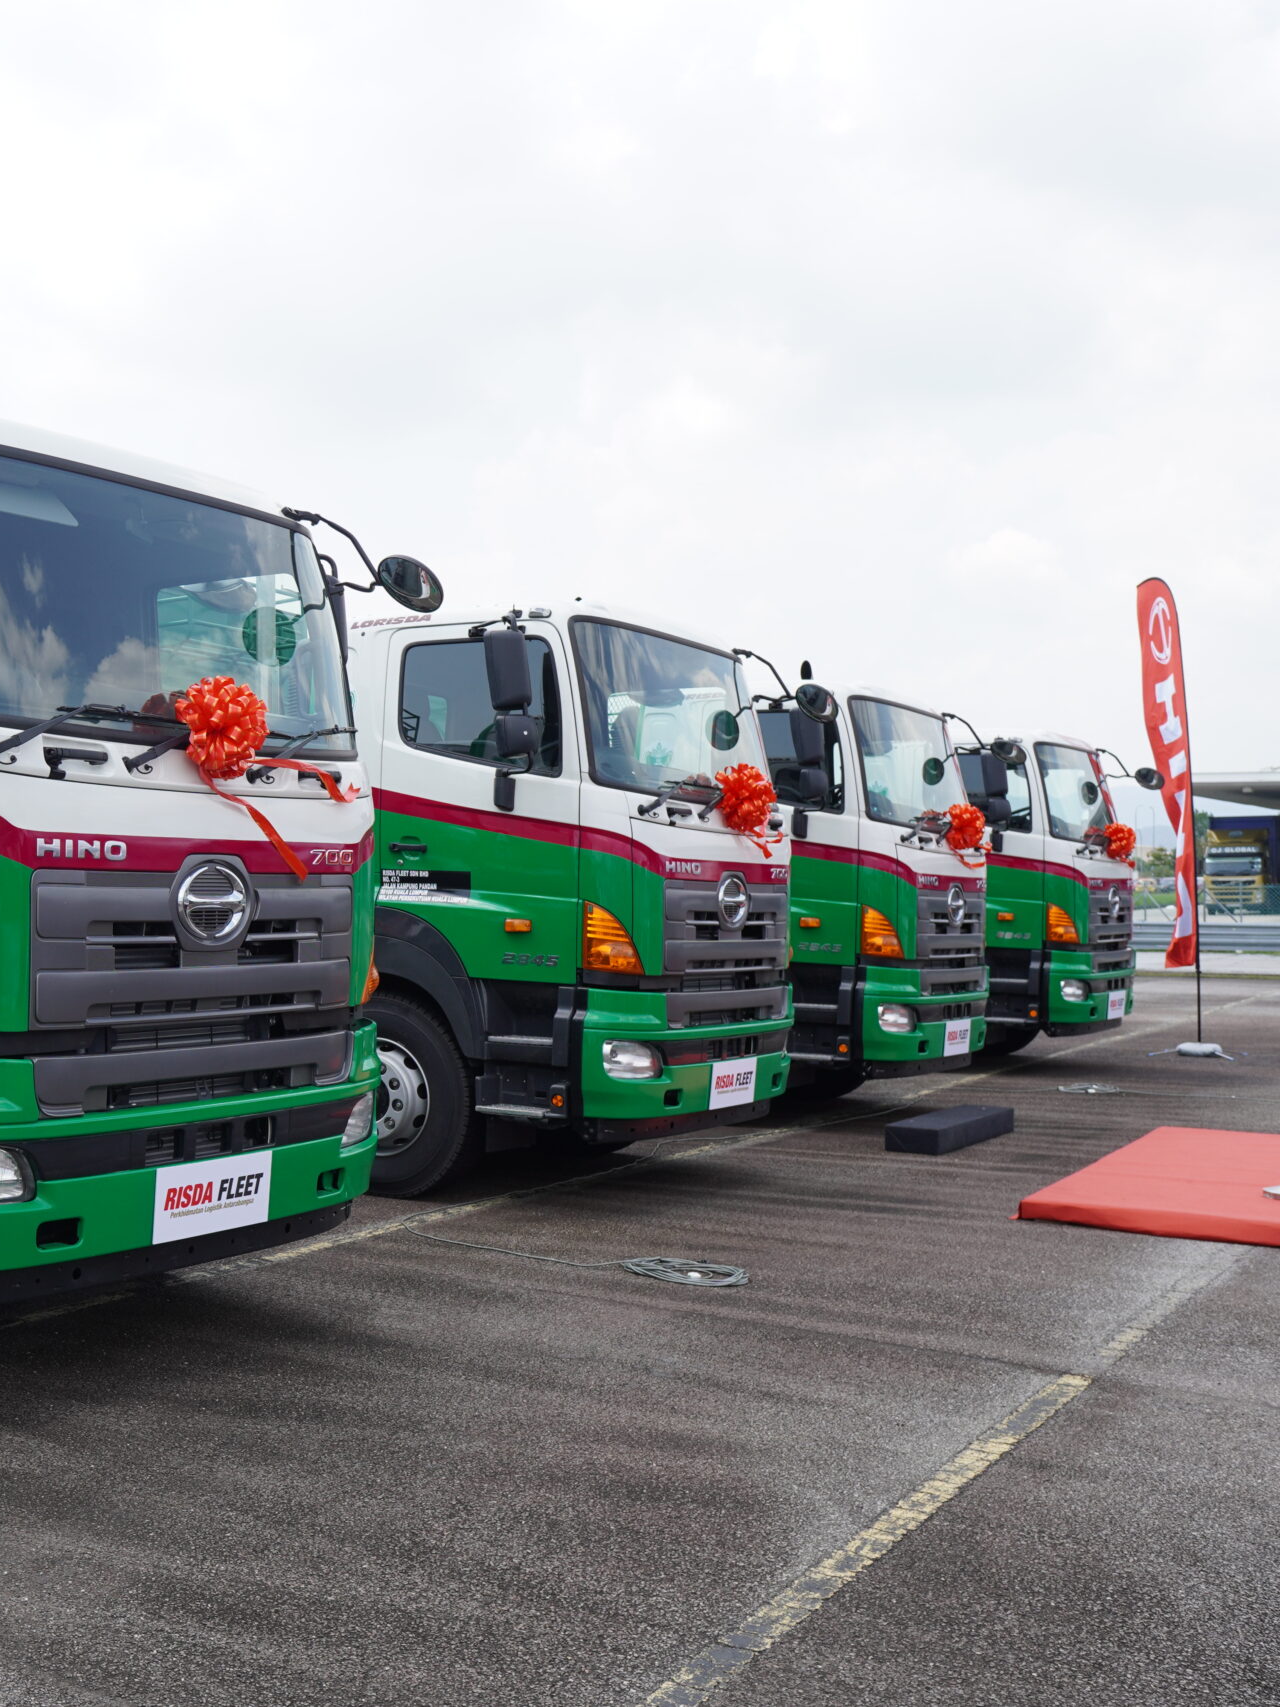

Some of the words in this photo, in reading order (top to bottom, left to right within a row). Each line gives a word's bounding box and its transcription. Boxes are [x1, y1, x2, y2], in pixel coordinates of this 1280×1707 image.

[36, 838, 127, 861] HINO
[310, 849, 354, 865] 700
[666, 860, 702, 875] HINO
[715, 1073, 734, 1090] RISDA
[735, 1070, 753, 1087] FLEET
[164, 1181, 213, 1211] RISDA
[217, 1172, 264, 1201] FLEET
